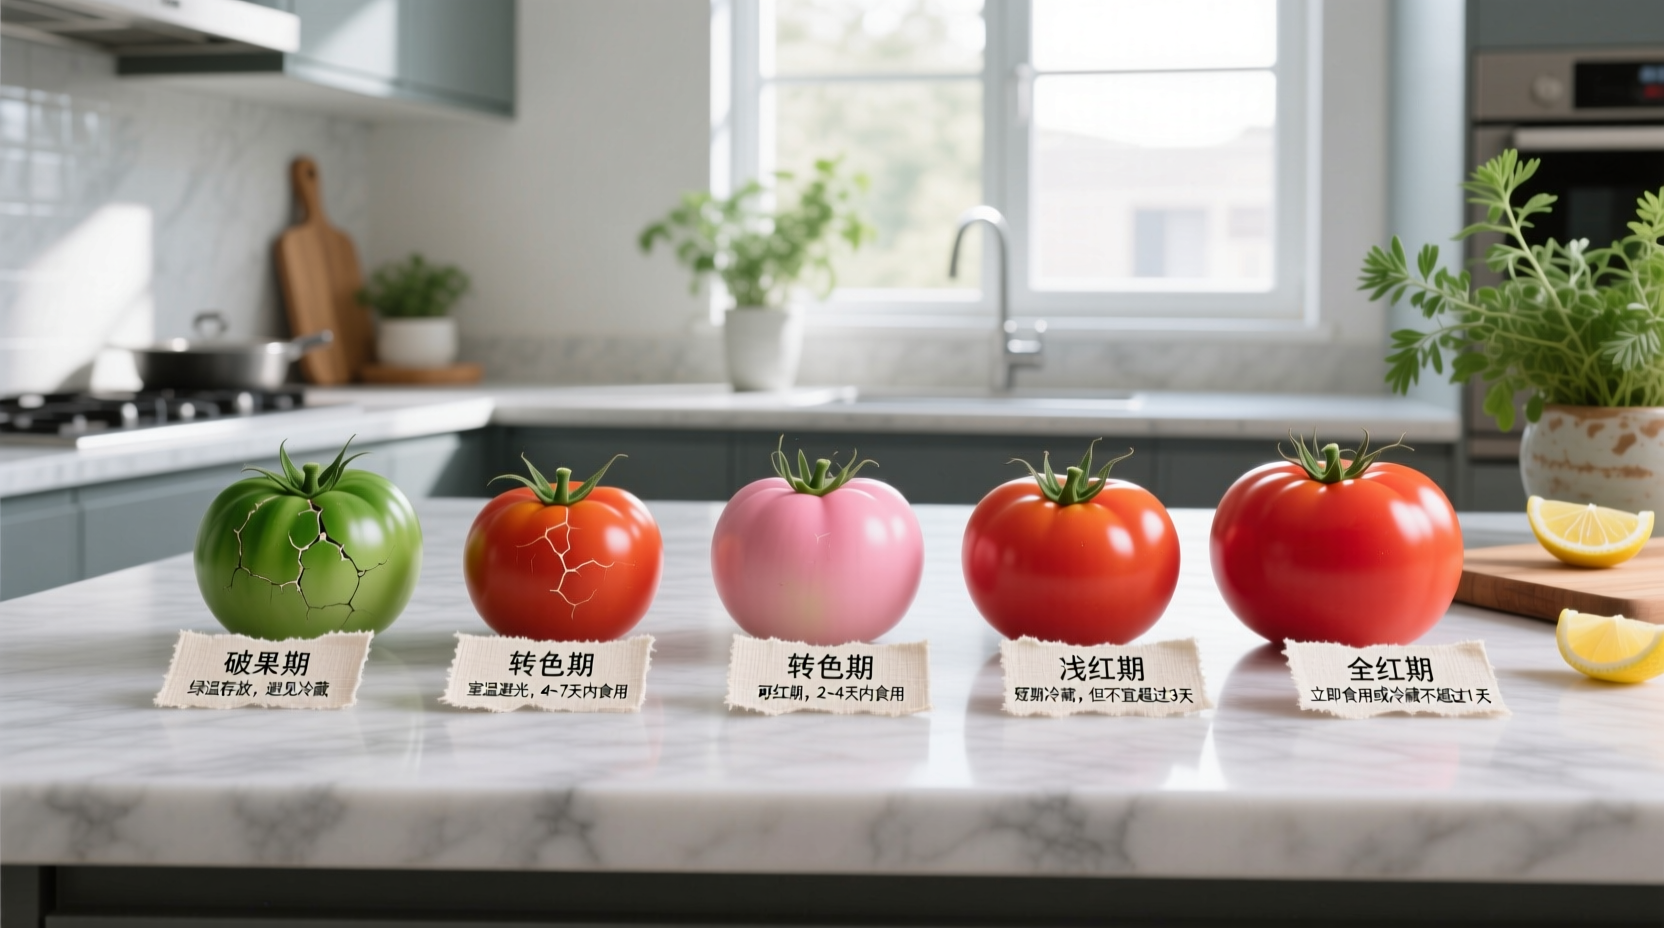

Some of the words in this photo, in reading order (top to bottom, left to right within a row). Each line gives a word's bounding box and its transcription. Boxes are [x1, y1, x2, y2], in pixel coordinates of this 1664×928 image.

[223, 649, 311, 677] 破果期
[508, 650, 595, 679] 转色期
[787, 652, 874, 681] 转色期
[1059, 654, 1145, 682] 浅红期
[1347, 655, 1434, 683] 全红期
